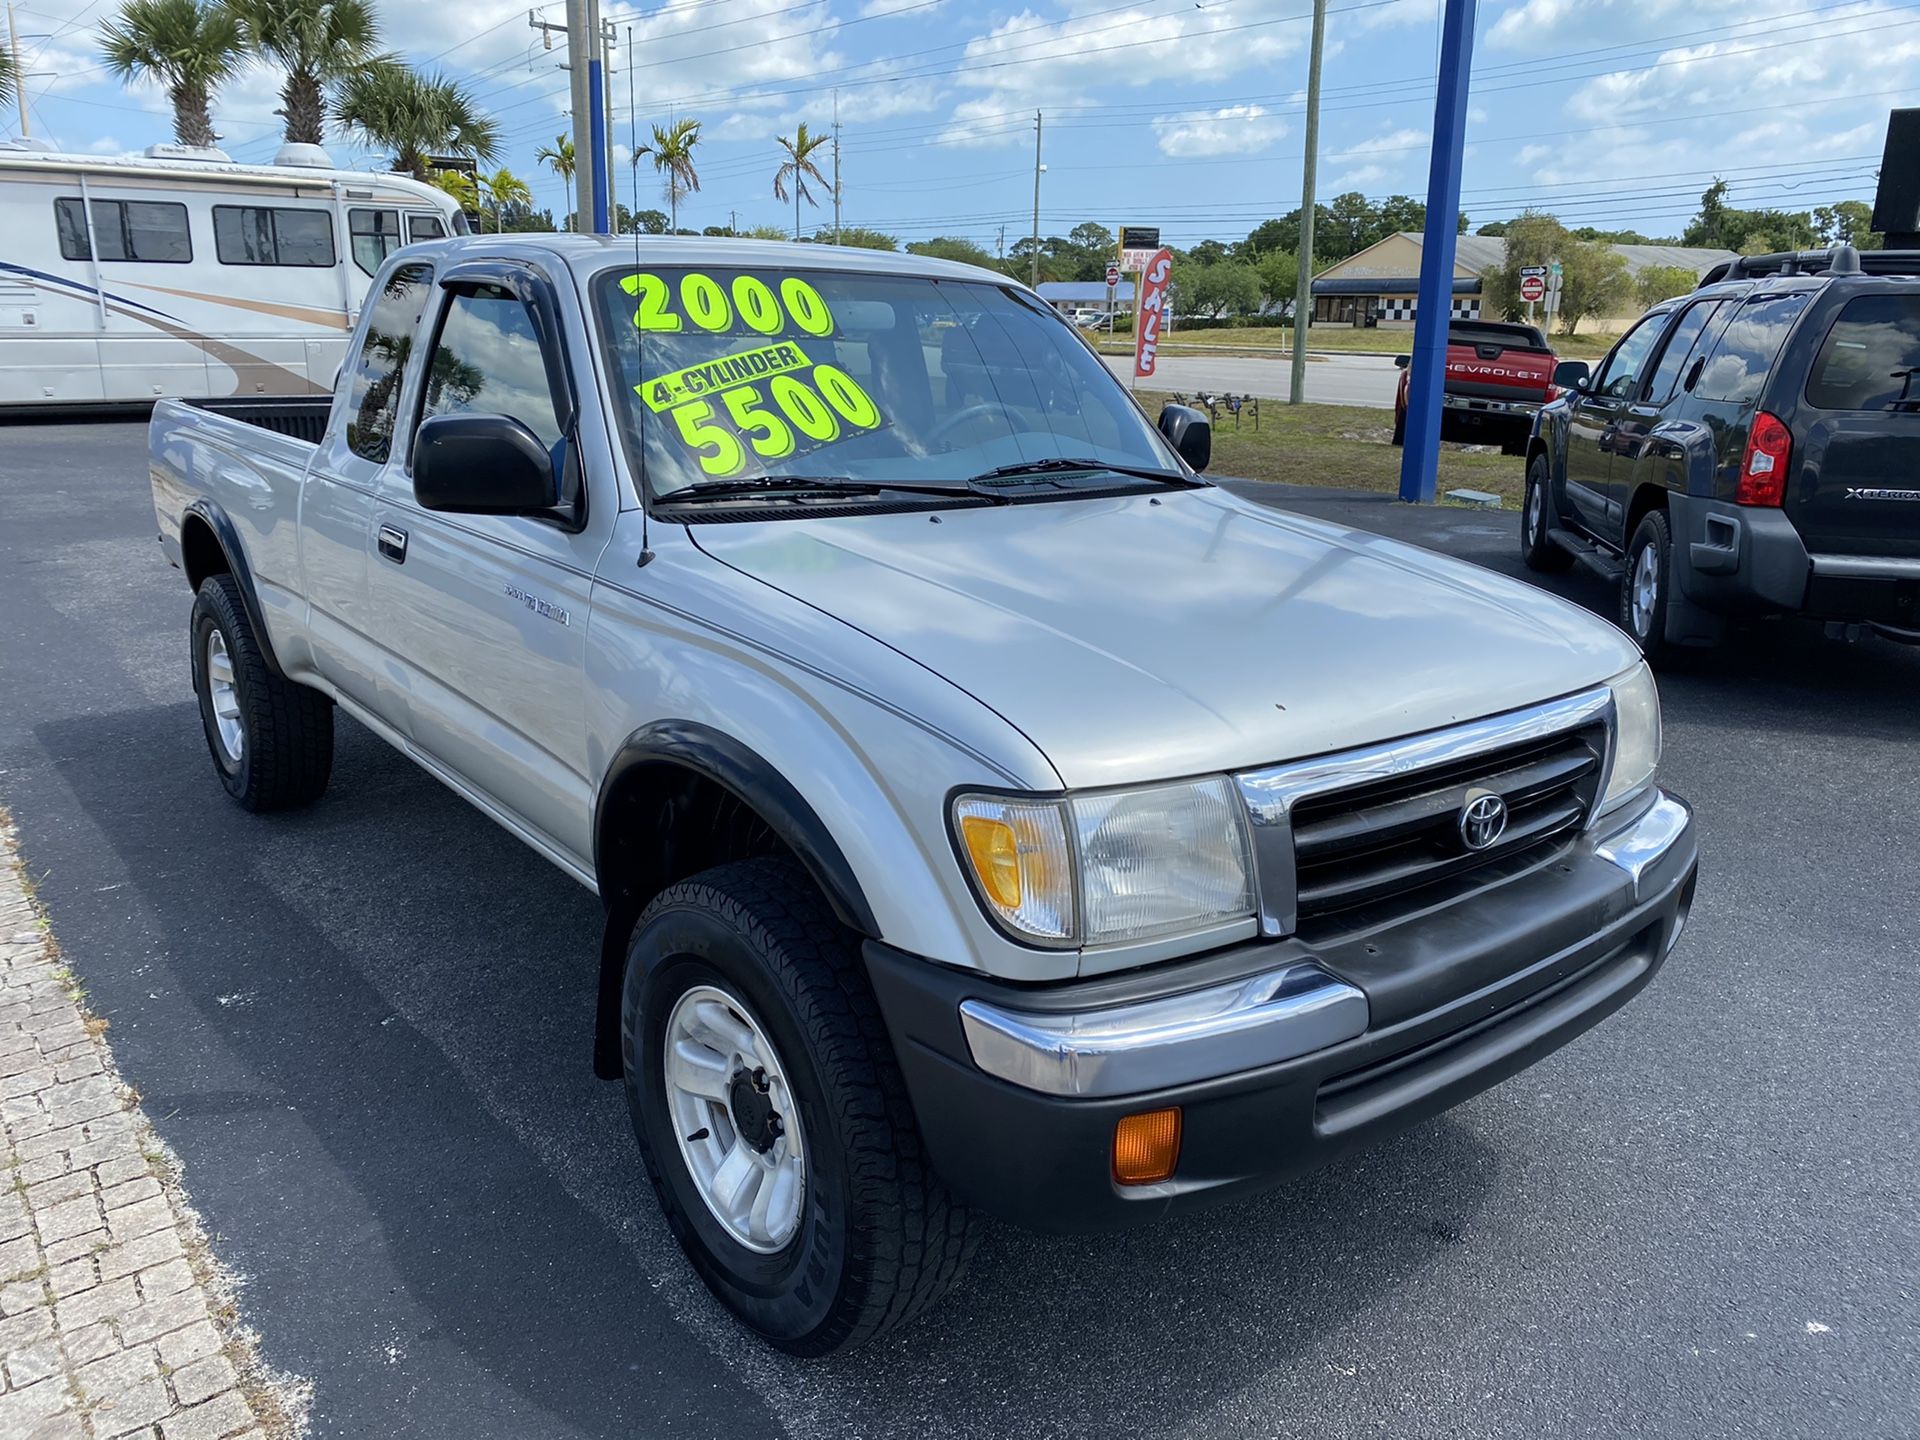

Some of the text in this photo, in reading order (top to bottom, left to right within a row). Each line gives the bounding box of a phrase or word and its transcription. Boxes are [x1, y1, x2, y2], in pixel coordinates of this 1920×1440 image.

[619, 273, 835, 337] 2000
[1140, 260, 1172, 372] SALE
[652, 346, 800, 406] 4-CYLINDER
[1445, 364, 1542, 379] HEVROLET
[671, 364, 882, 476] 5500
